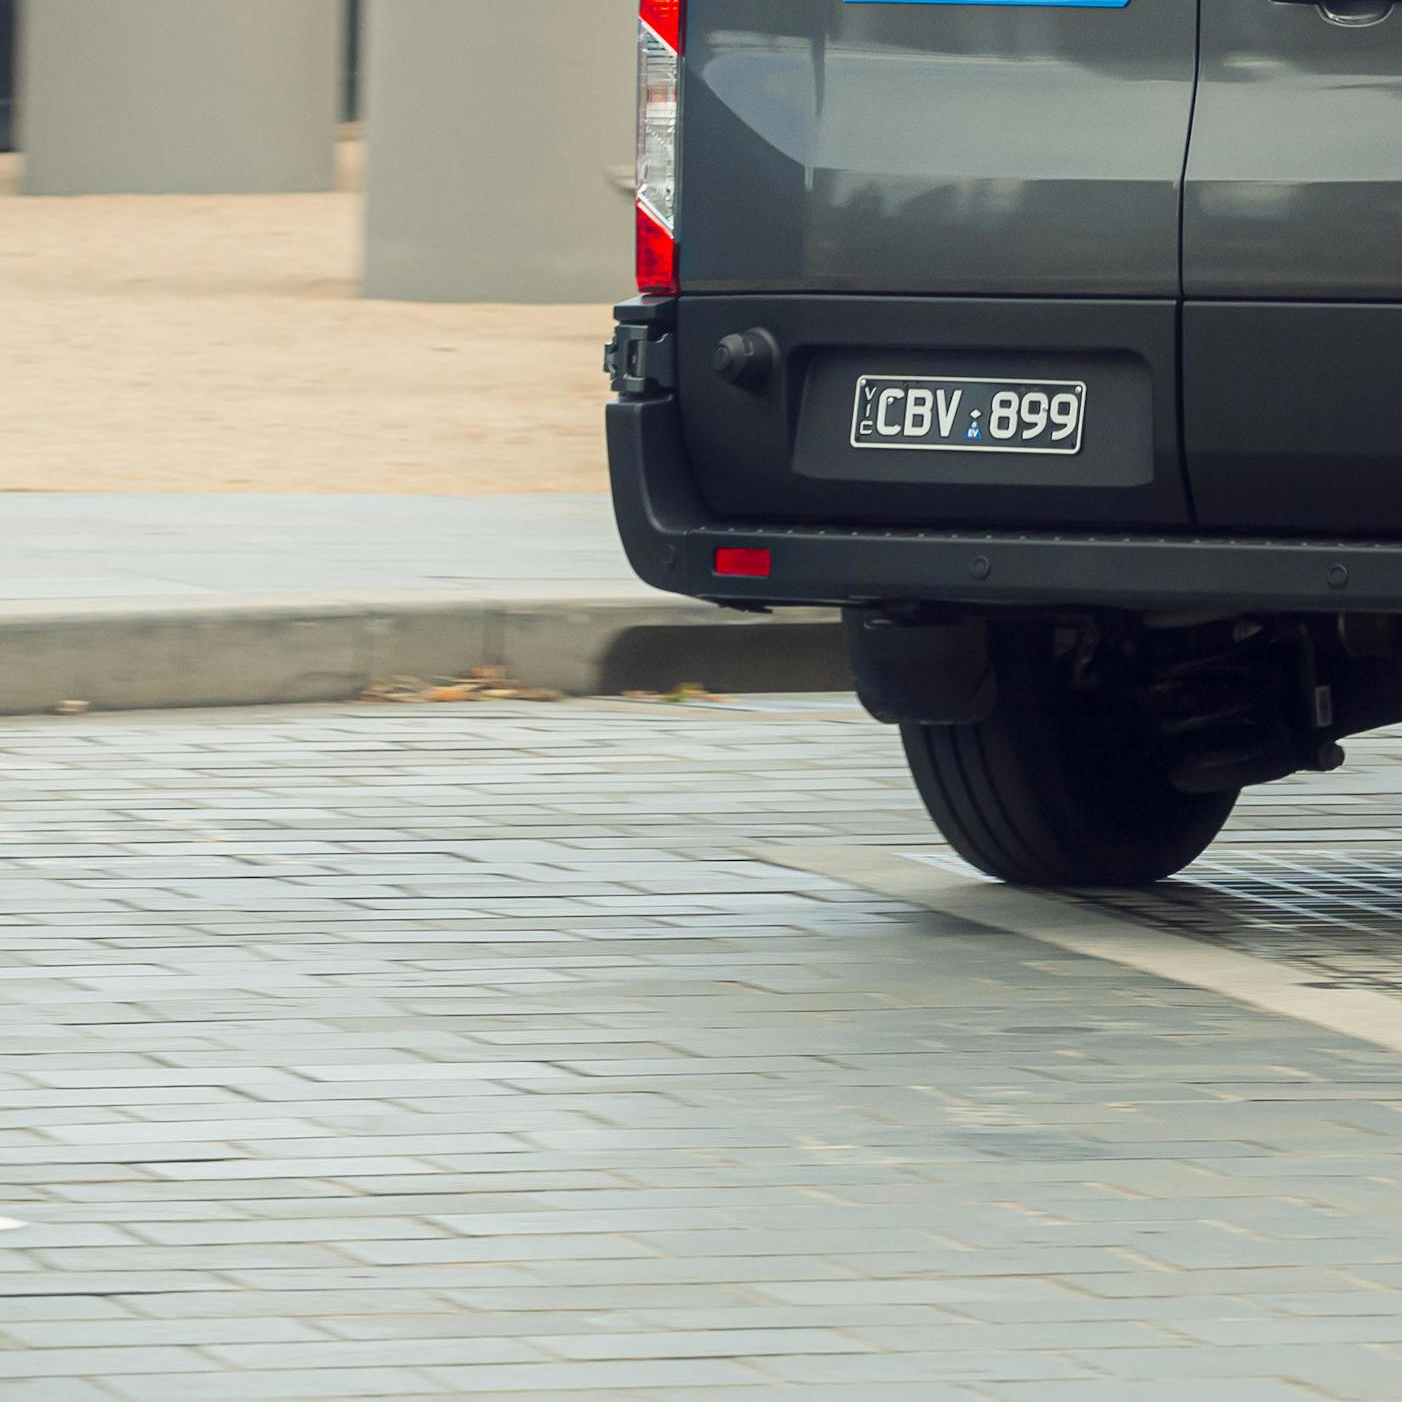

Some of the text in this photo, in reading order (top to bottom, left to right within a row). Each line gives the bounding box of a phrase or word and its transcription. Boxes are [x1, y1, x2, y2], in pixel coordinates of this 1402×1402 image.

[859, 386, 877, 435] VIC
[876, 387, 1079, 440] CBV 899
